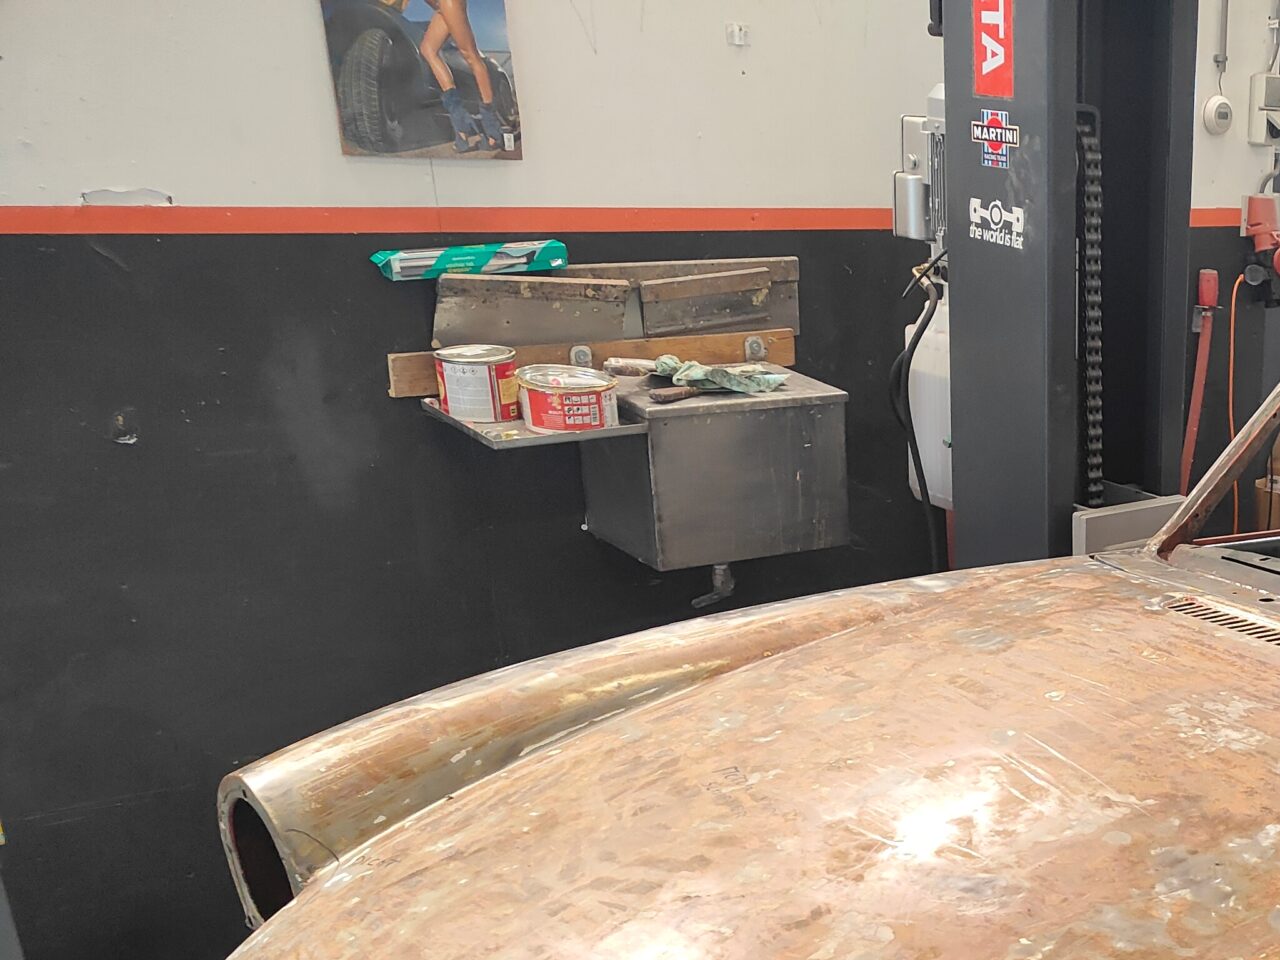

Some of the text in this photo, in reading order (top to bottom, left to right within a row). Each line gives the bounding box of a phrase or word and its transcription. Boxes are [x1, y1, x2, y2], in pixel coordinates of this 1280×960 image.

[981, 0, 1005, 75] TA
[973, 126, 1017, 144] MARTINI
[969, 222, 1024, 250] the world is flat
